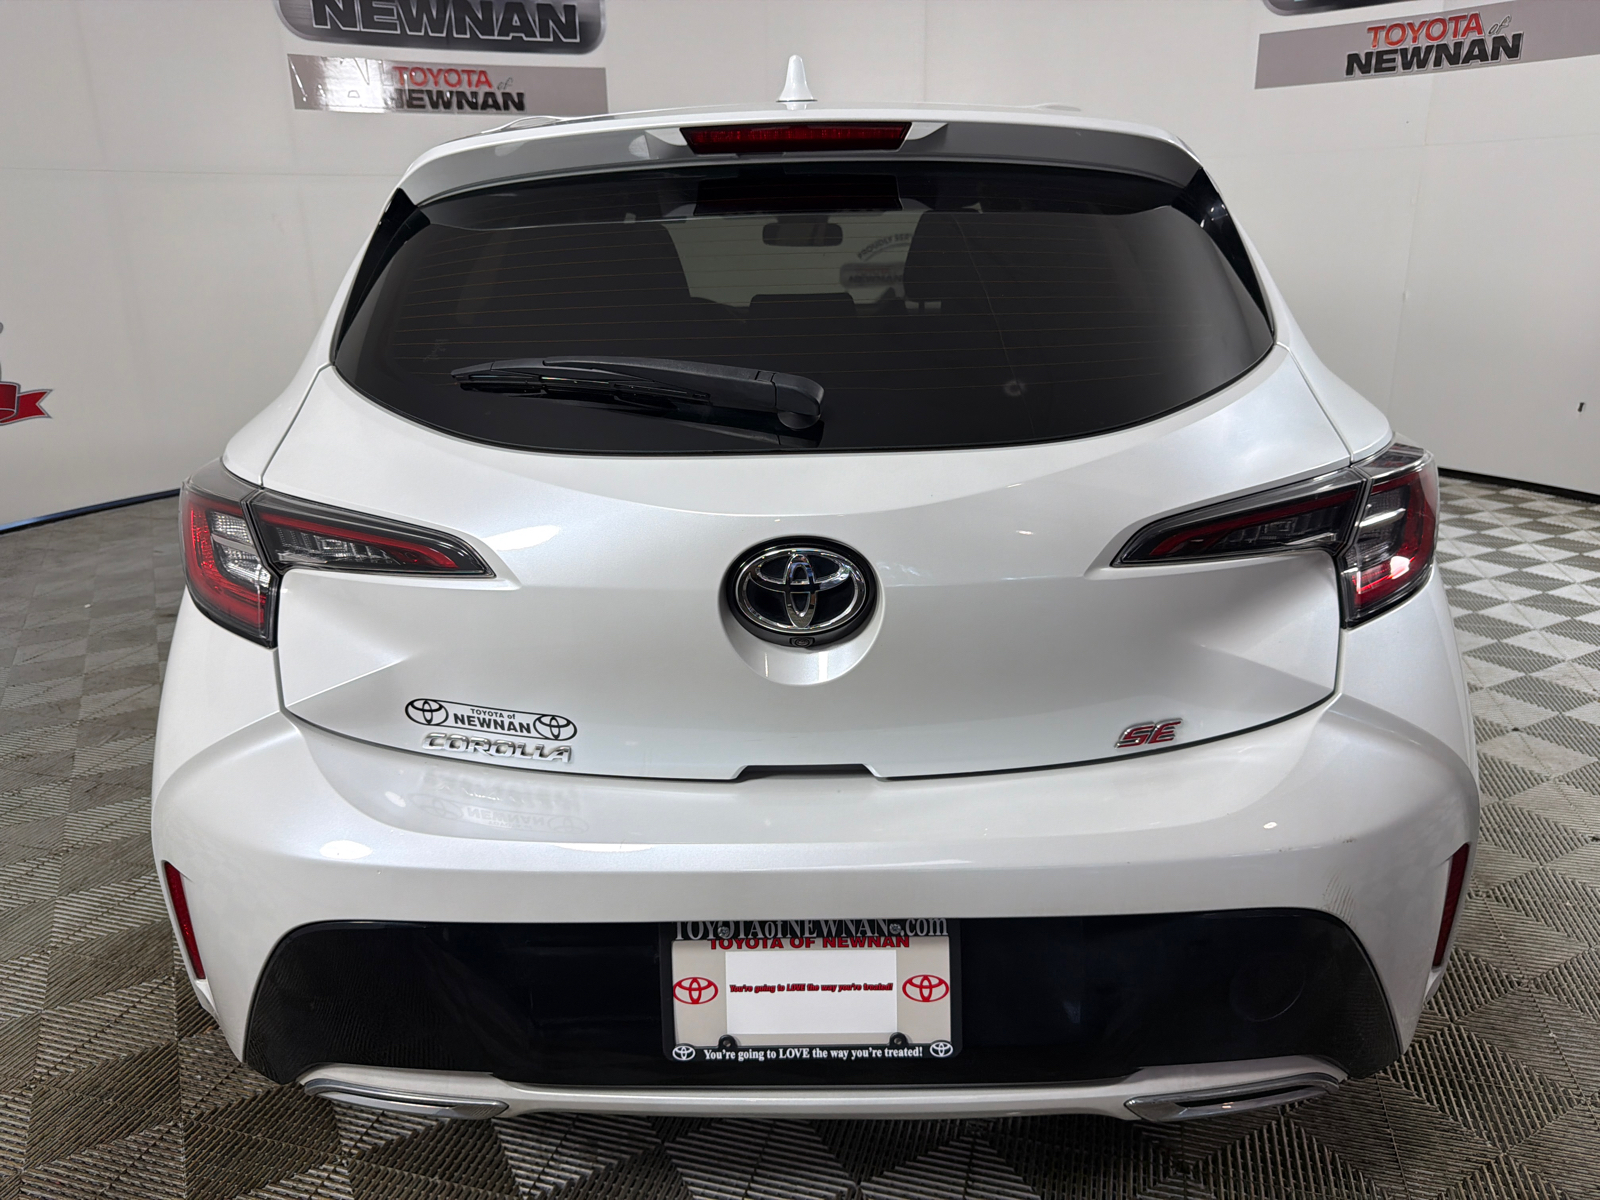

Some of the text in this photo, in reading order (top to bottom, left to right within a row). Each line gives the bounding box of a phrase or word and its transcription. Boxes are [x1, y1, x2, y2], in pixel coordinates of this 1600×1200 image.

[311, 0, 581, 42] NEWNAN
[1366, 12, 1512, 49] TOYOTA of
[1344, 31, 1524, 77] NEWNAN
[392, 65, 513, 90] TOYOTA of
[453, 713, 532, 734] NEWNAN
[470, 708, 504, 719] TOYOTA
[1114, 718, 1182, 748] SE
[421, 731, 573, 763] COROLLA
[708, 936, 910, 950] TOYOTA OF NEWNAN
[754, 984, 776, 994] going
[777, 984, 785, 992] to
[786, 983, 806, 992] LOVE
[807, 983, 820, 992] the
[821, 984, 837, 993] way
[703, 1047, 923, 1062] You're going to LOVE the way you're treated!
